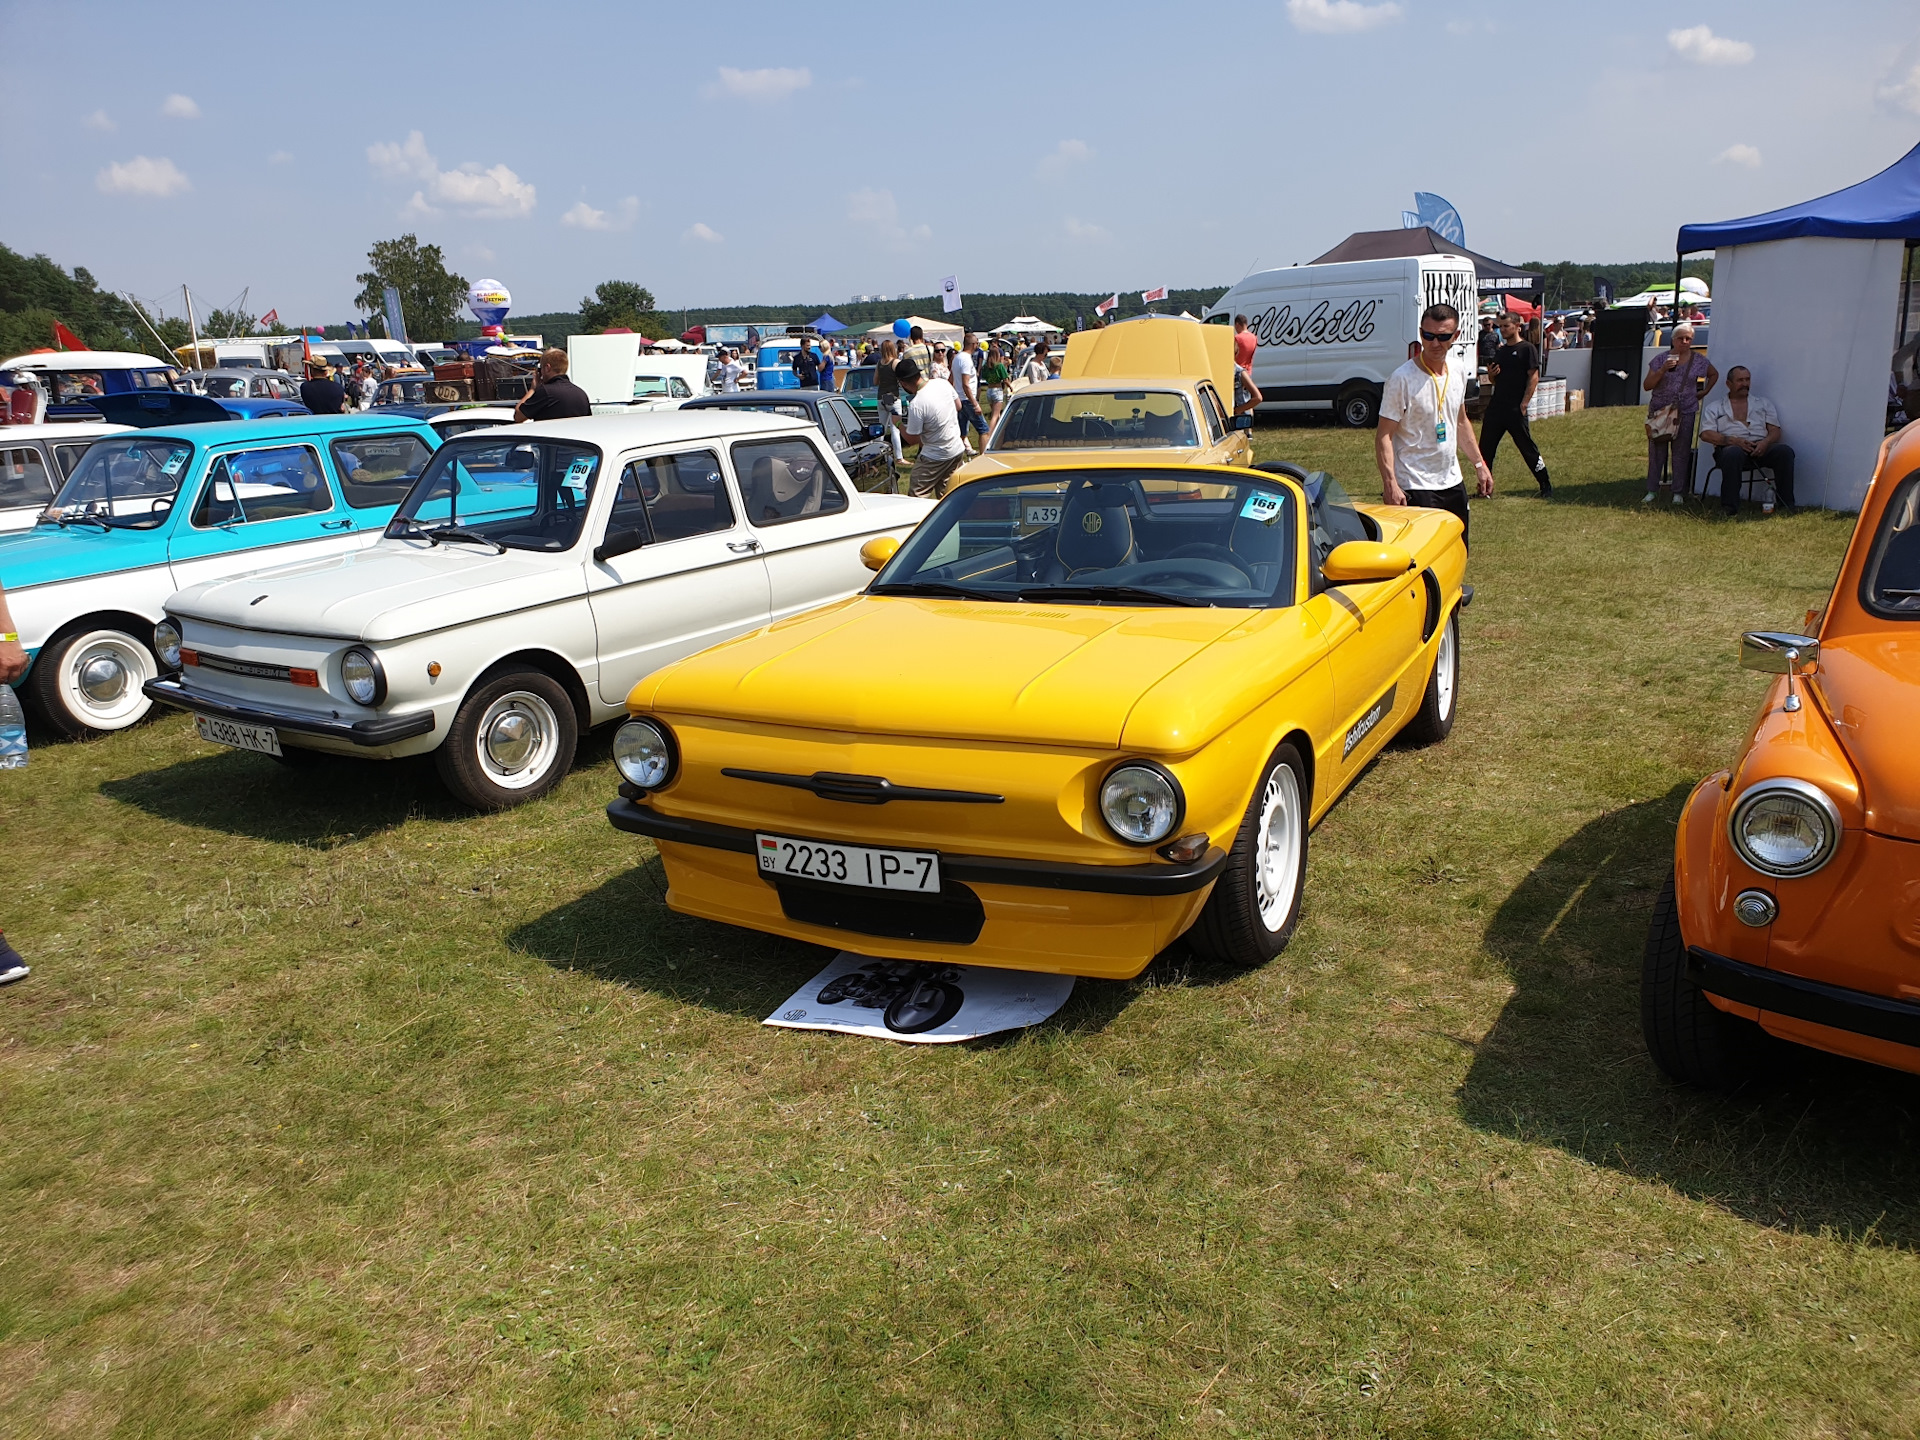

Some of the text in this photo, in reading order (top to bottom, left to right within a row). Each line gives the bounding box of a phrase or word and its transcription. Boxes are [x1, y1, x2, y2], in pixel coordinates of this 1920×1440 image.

[170, 454, 185, 463] 249
[571, 464, 588, 474] 150
[1252, 498, 1276, 510] 168
[209, 720, 240, 745] 4388
[239, 726, 275, 752] HK-7
[762, 842, 933, 889] BY 2233 IP-7
